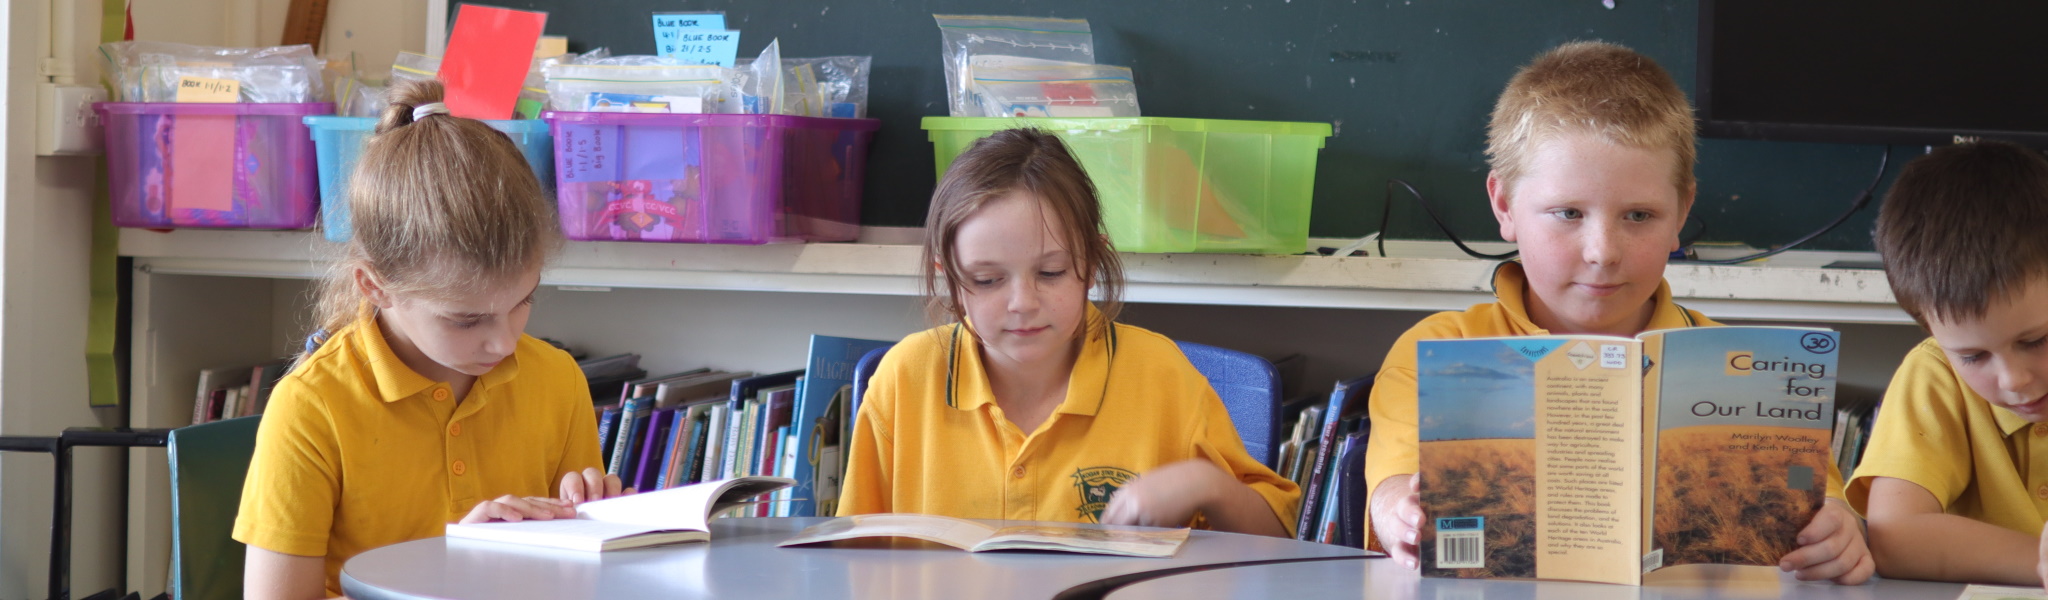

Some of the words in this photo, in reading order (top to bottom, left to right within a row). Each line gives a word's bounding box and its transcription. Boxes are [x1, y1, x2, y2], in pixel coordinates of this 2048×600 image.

[657, 18, 675, 27] BLUE
[679, 19, 699, 27] BOOK
[683, 33, 704, 42] BLUE
[182, 79, 201, 88] BOOK
[565, 131, 573, 152] BOOK
[593, 129, 602, 152] Book
[565, 158, 574, 178] BLUE
[1806, 337, 1830, 350] 30
[1730, 354, 1826, 379] Caring
[1786, 377, 1826, 397] for
[1691, 400, 1746, 417] Our
[1756, 401, 1823, 421] Land
[1731, 433, 1772, 442] Marilyn
[1775, 434, 1820, 444] Woolley
[1314, 440, 1329, 475] Dreaming
[1752, 444, 1779, 452] Keith
[1782, 445, 1821, 455] Pigdon
